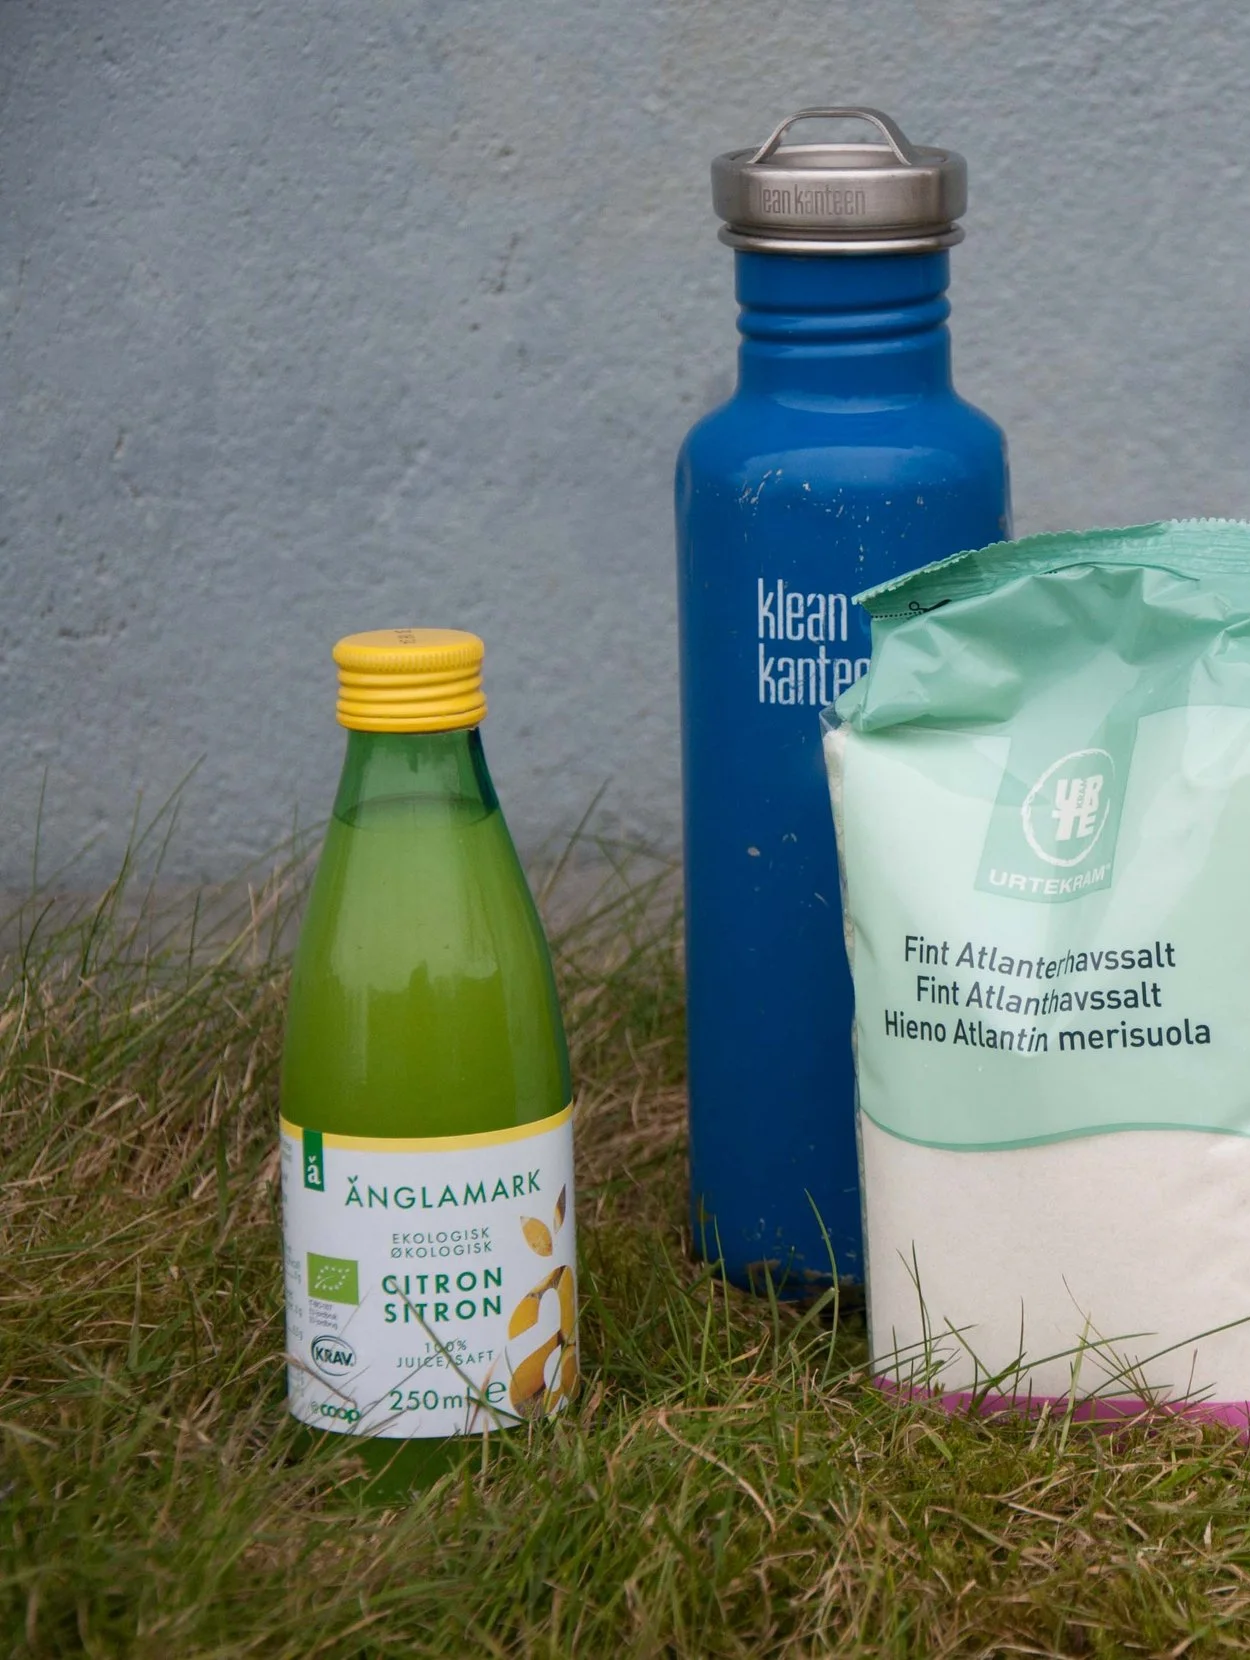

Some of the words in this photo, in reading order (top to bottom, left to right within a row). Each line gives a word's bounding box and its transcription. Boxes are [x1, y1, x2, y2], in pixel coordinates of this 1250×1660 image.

[795, 183, 866, 216] kanteen
[758, 578, 848, 641] klean
[988, 865, 1107, 895] URTEKRAM
[905, 935, 949, 966] Fint
[955, 940, 1176, 980] Atlanterhavssalt
[917, 975, 959, 1006] Fint
[965, 981, 1162, 1016] Atlanthavssalt
[885, 1009, 946, 1043] Hieno
[953, 1018, 1048, 1052] Atlantin
[1059, 1018, 1211, 1051] merisuola
[391, 1241, 492, 1259] ØKOLOGISK
[392, 1227, 490, 1245] EKOLOGISK
[382, 1267, 502, 1295] CITRON
[384, 1295, 501, 1323] SITRON
[320, 1404, 360, 1424] coop
